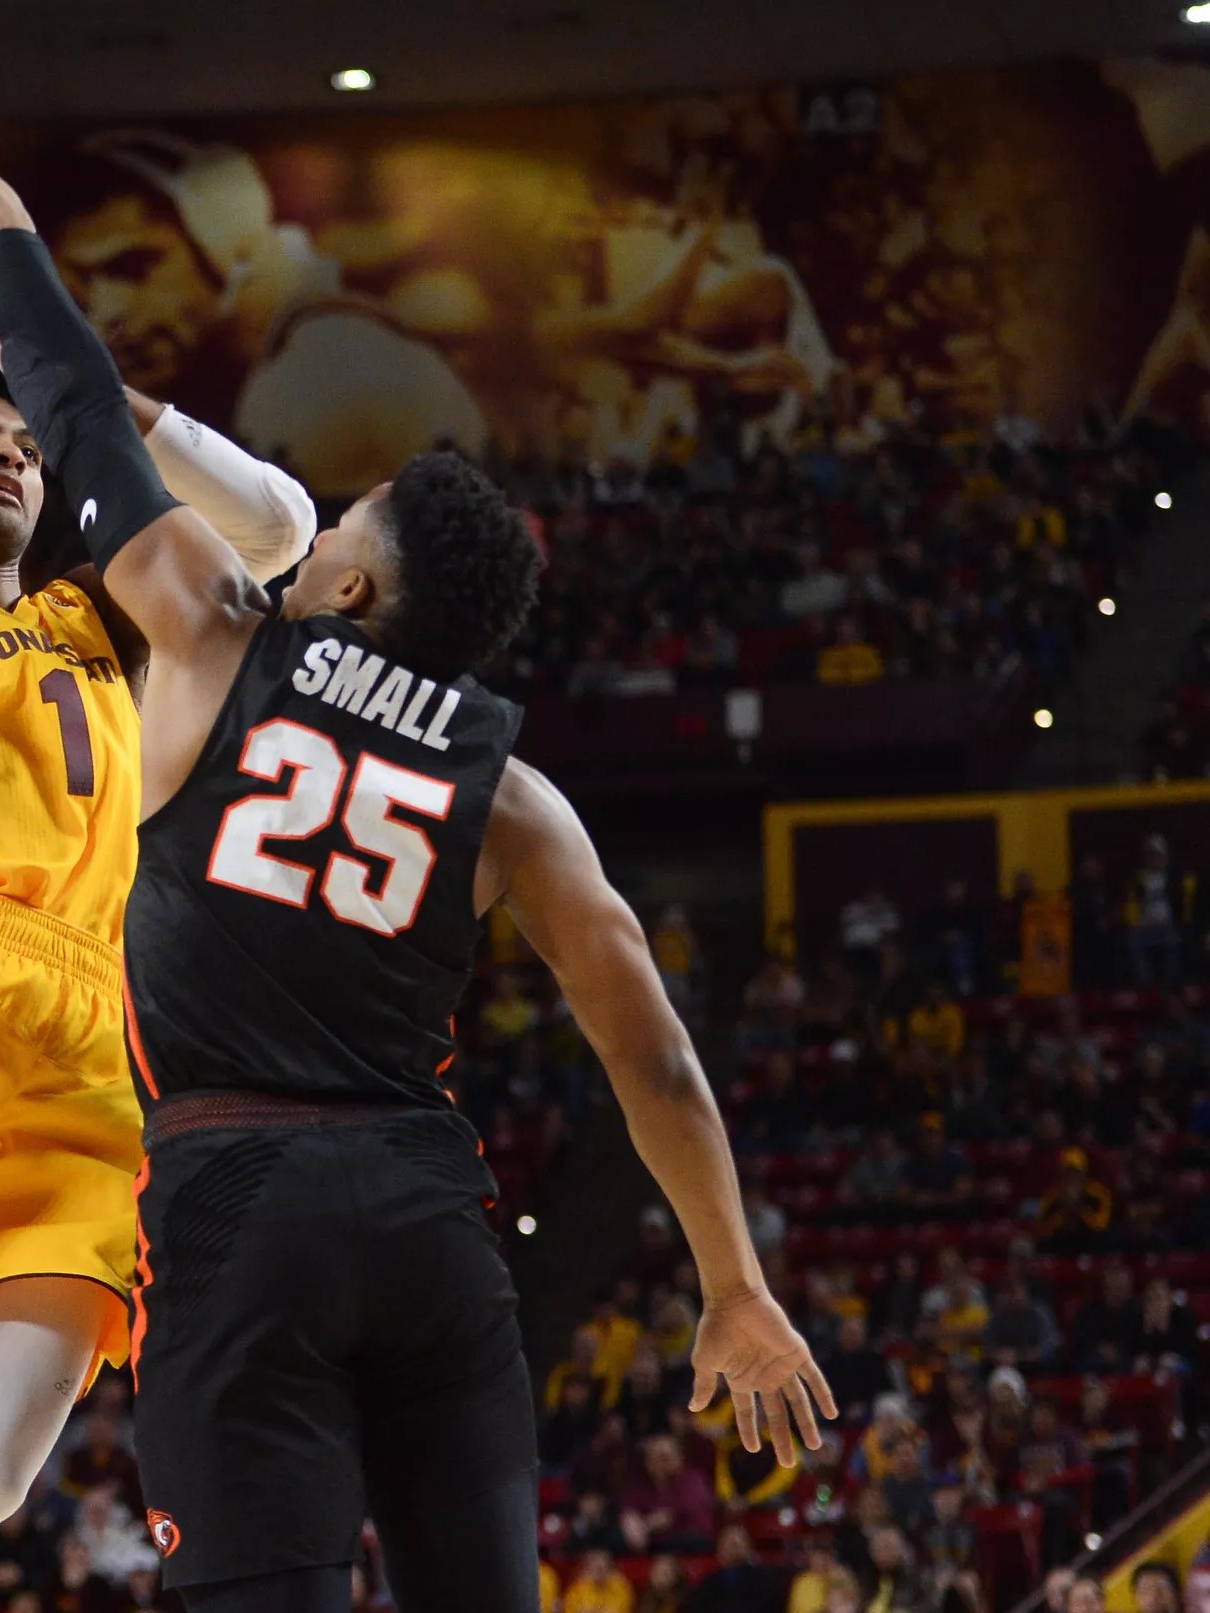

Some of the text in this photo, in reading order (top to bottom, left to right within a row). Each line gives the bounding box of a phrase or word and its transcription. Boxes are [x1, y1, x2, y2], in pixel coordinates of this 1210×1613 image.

[38, 667, 94, 797] 1
[292, 638, 461, 752] SMALL
[206, 716, 456, 937] 25
